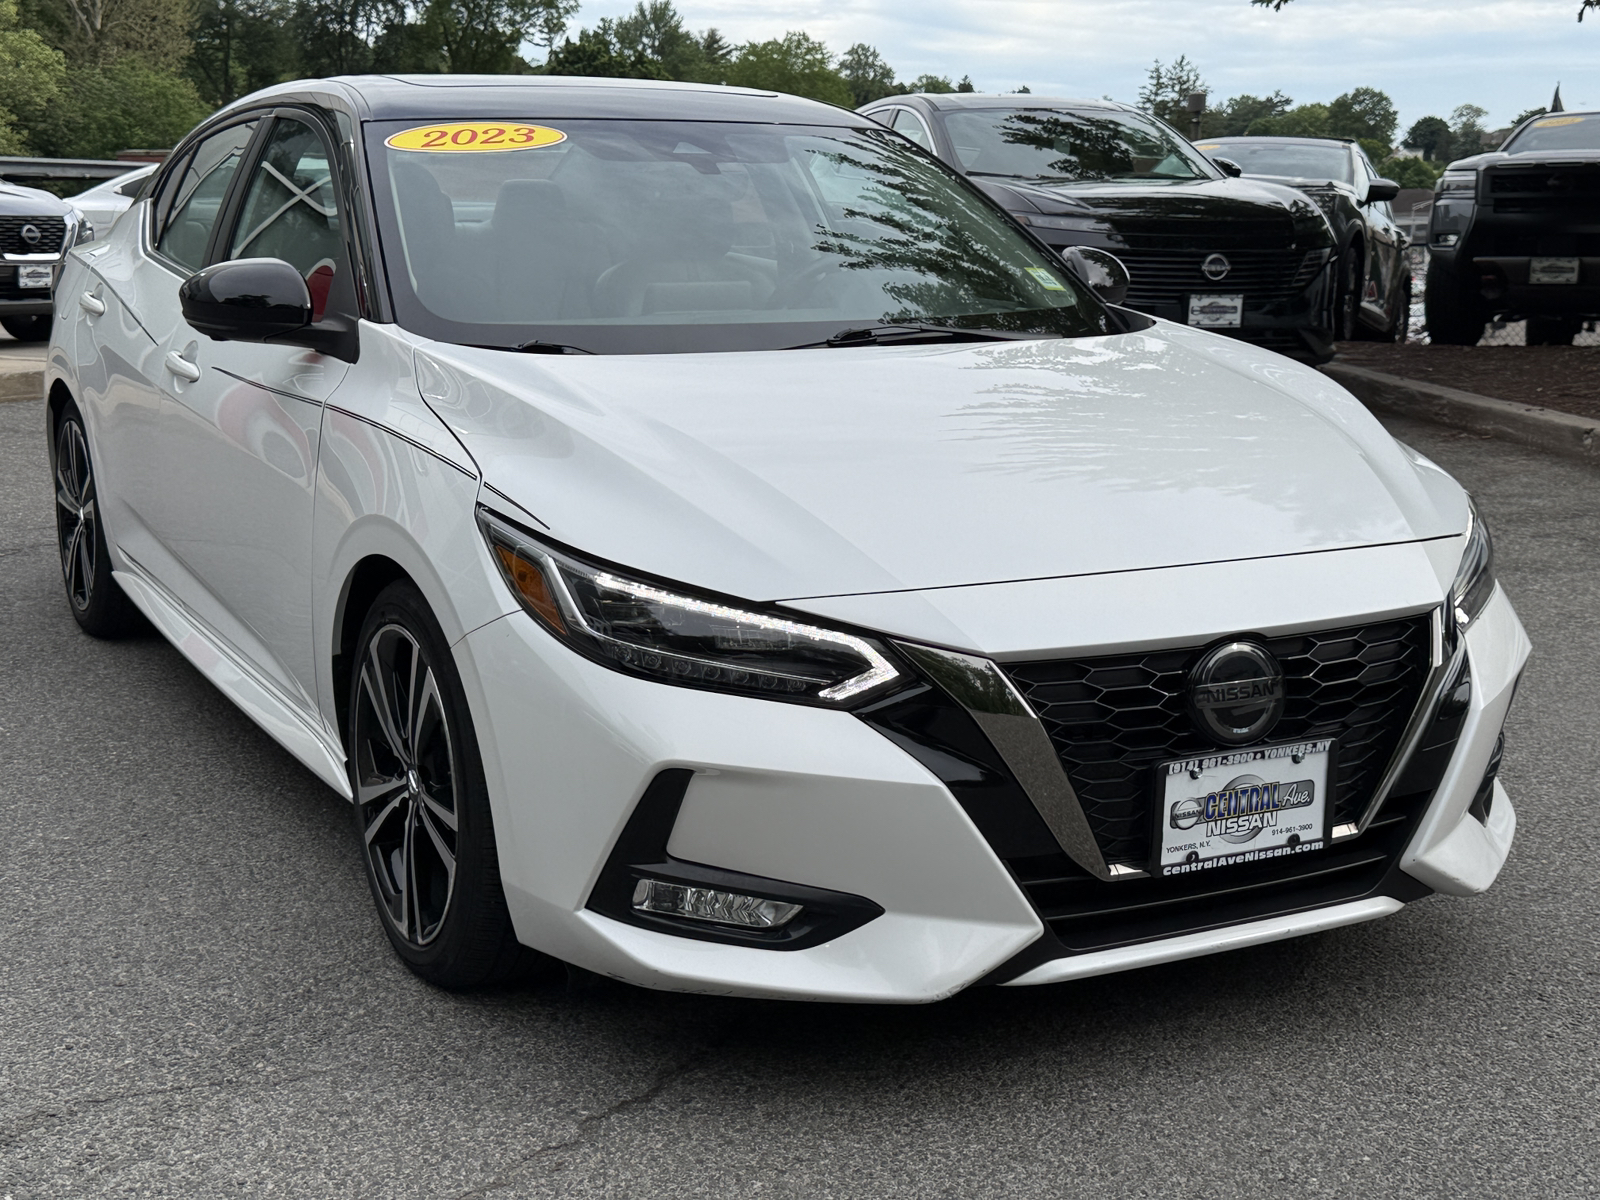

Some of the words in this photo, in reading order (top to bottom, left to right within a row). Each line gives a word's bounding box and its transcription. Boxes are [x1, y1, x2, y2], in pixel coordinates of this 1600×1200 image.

[421, 127, 536, 148] 2023
[1206, 681, 1275, 703] NISSAN
[1202, 752, 1254, 769] 961-3900
[1203, 781, 1280, 821] CENTRAL
[1282, 783, 1311, 807] Ave.
[1174, 809, 1200, 819] NISSAN
[1206, 811, 1278, 837] NISSAN
[1271, 823, 1313, 836] 914-961-3900
[1166, 842, 1199, 854] YONKERS,
